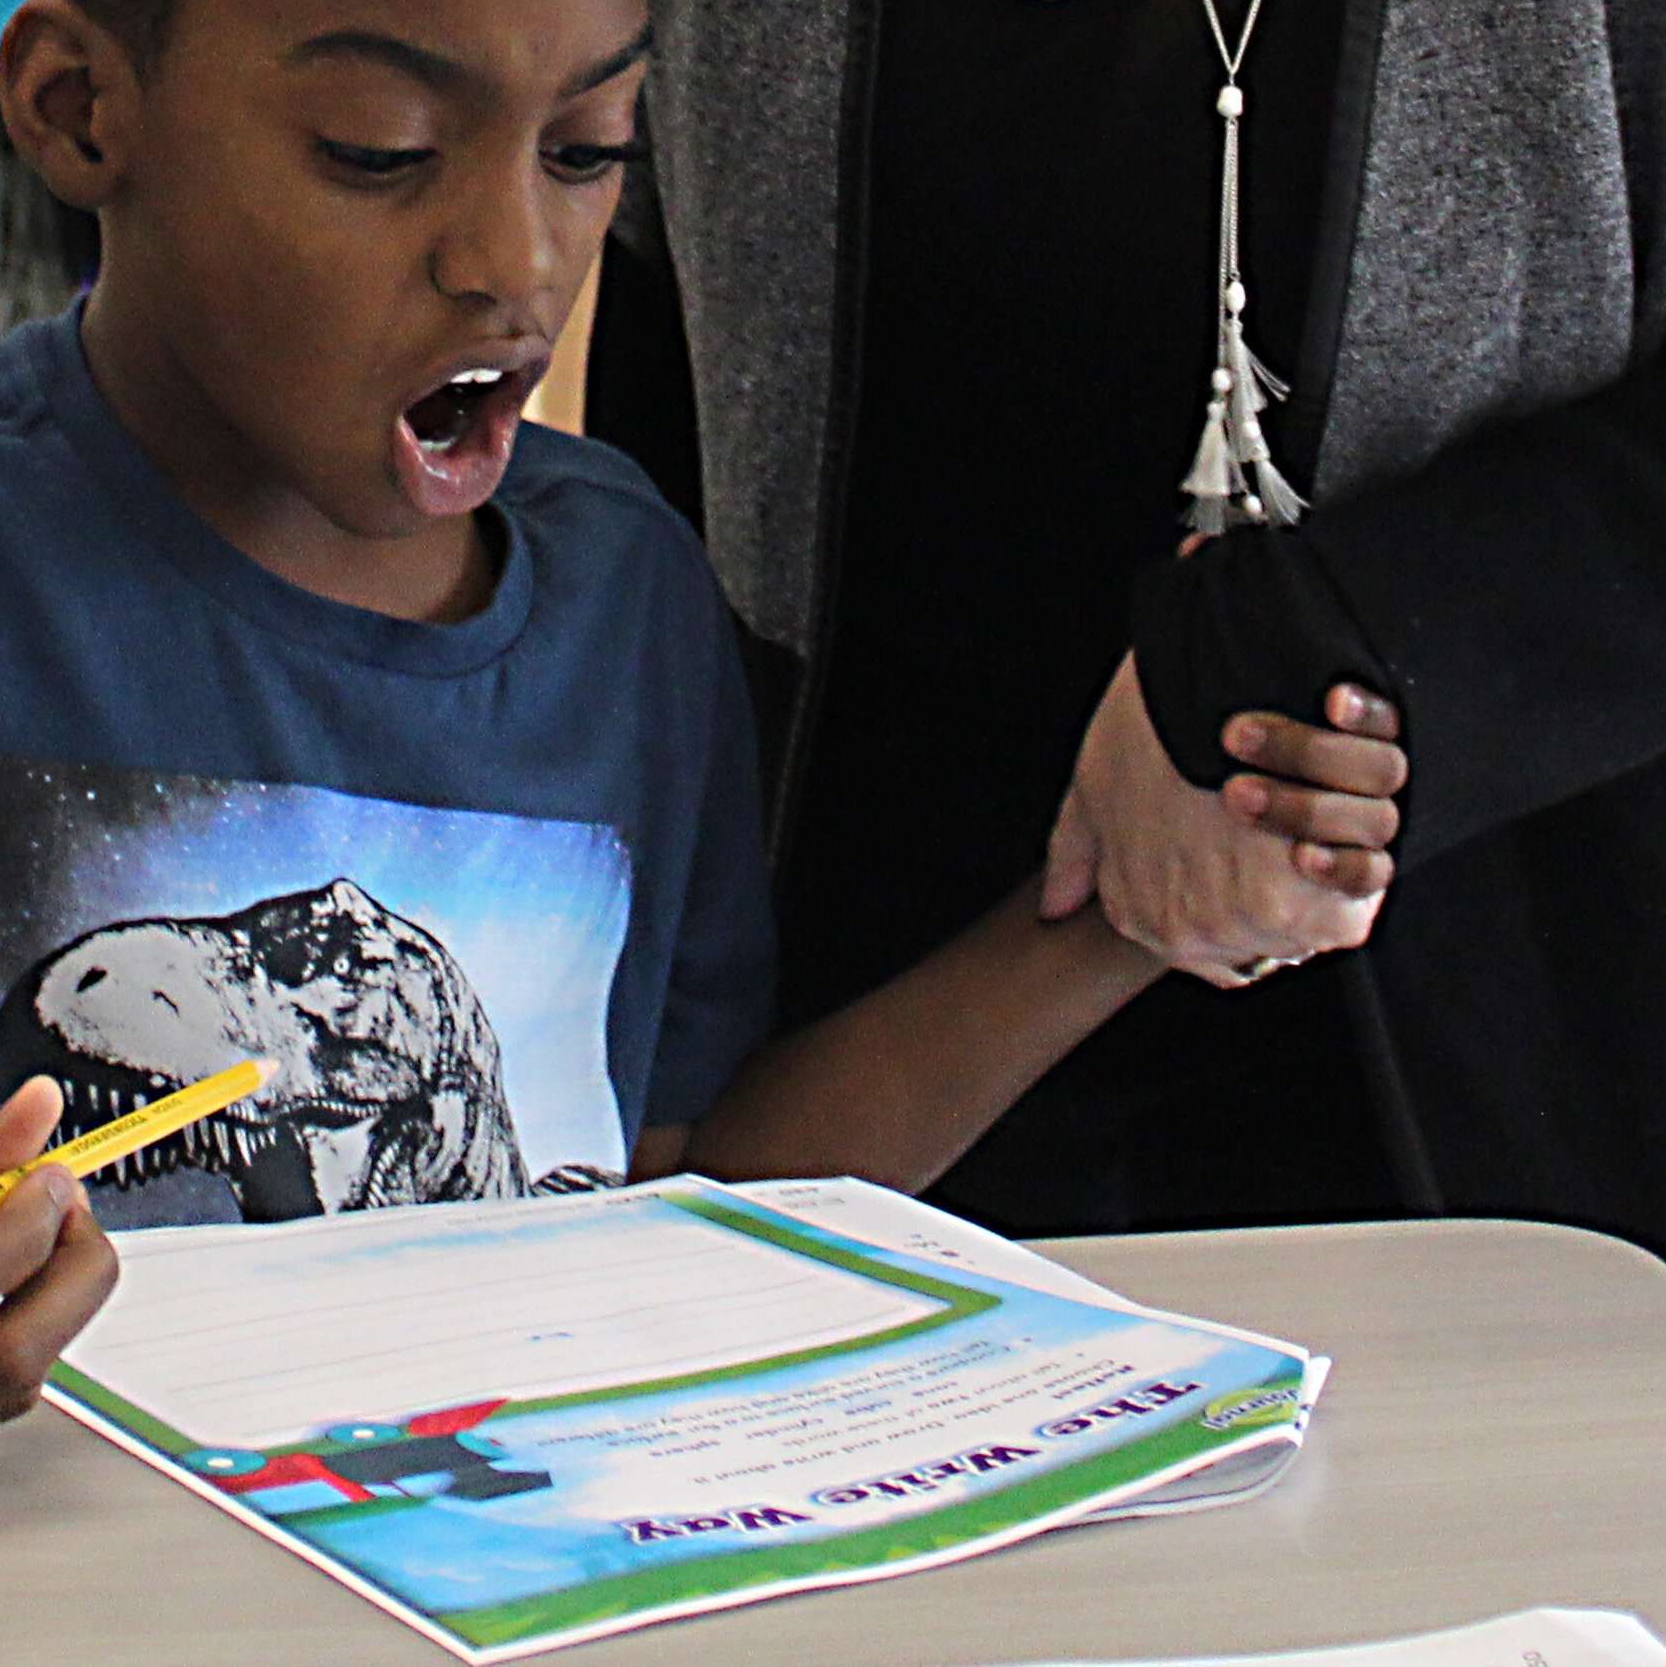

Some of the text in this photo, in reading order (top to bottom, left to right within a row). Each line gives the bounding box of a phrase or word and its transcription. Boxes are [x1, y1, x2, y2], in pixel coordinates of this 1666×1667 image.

[1200, 1388, 1298, 1430] Journal
[745, 1418, 824, 1440] cylinder
[617, 1381, 1204, 1545] The Write Way
[649, 1438, 721, 1459] sphere
